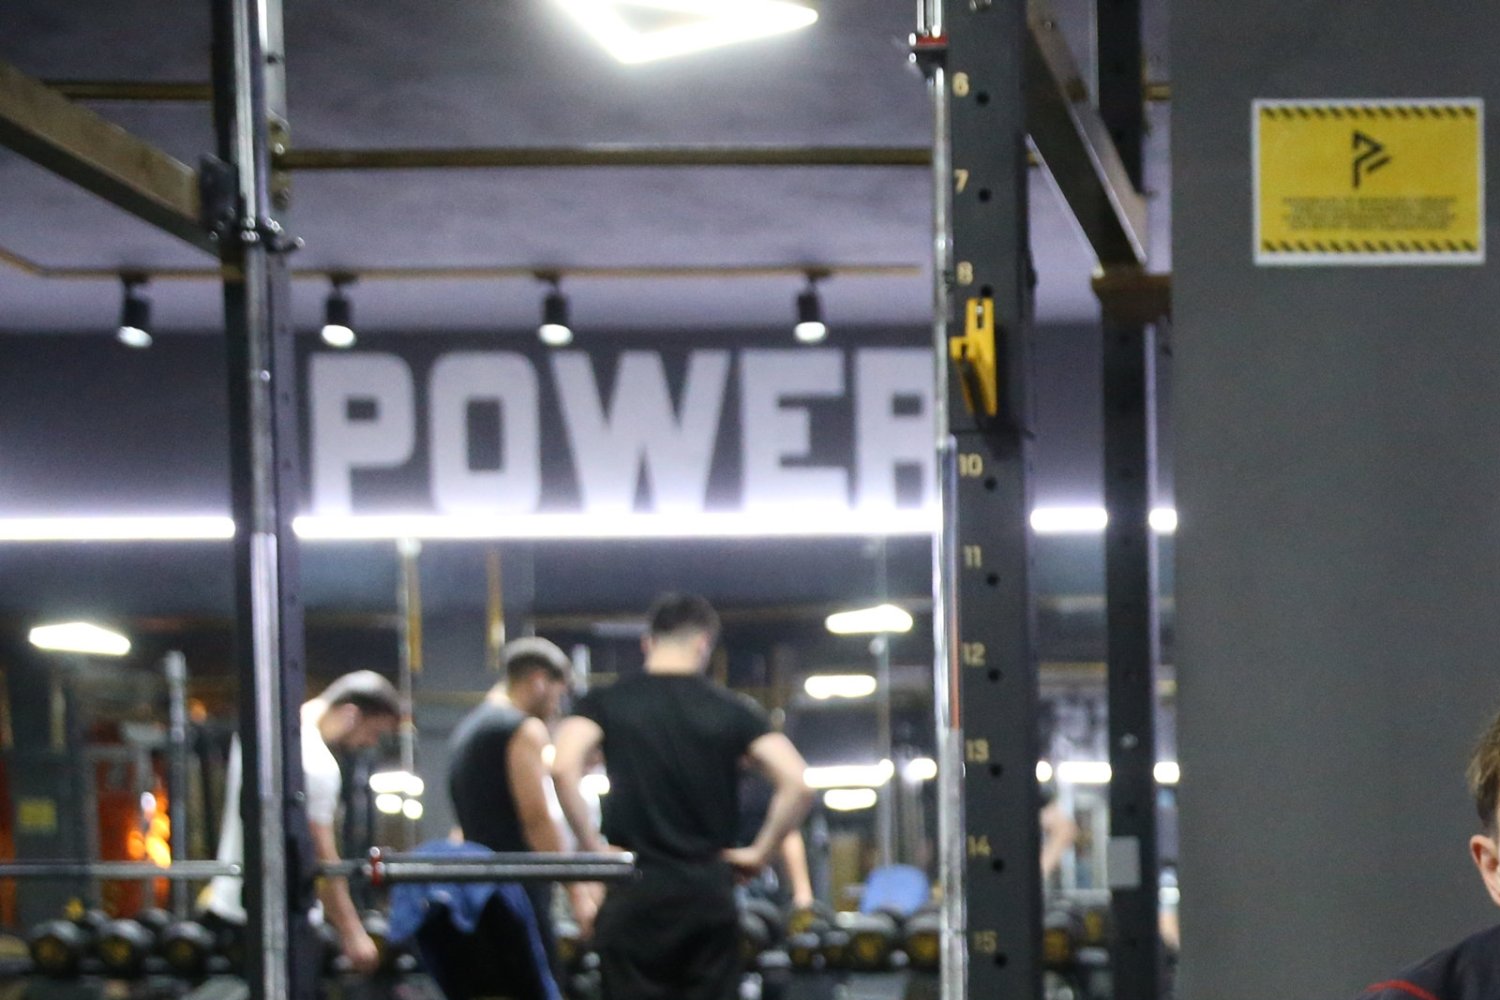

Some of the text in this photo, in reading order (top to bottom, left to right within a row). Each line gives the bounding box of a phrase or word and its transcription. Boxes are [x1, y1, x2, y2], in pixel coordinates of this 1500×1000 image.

[952, 72, 969, 97] 6
[954, 169, 969, 194] 7
[957, 261, 973, 286] 8
[310, 350, 938, 514] POWER
[958, 453, 983, 477] 10
[963, 545, 982, 569] 11
[962, 641, 986, 666] 12
[966, 739, 990, 763] 13
[967, 834, 992, 858] 14
